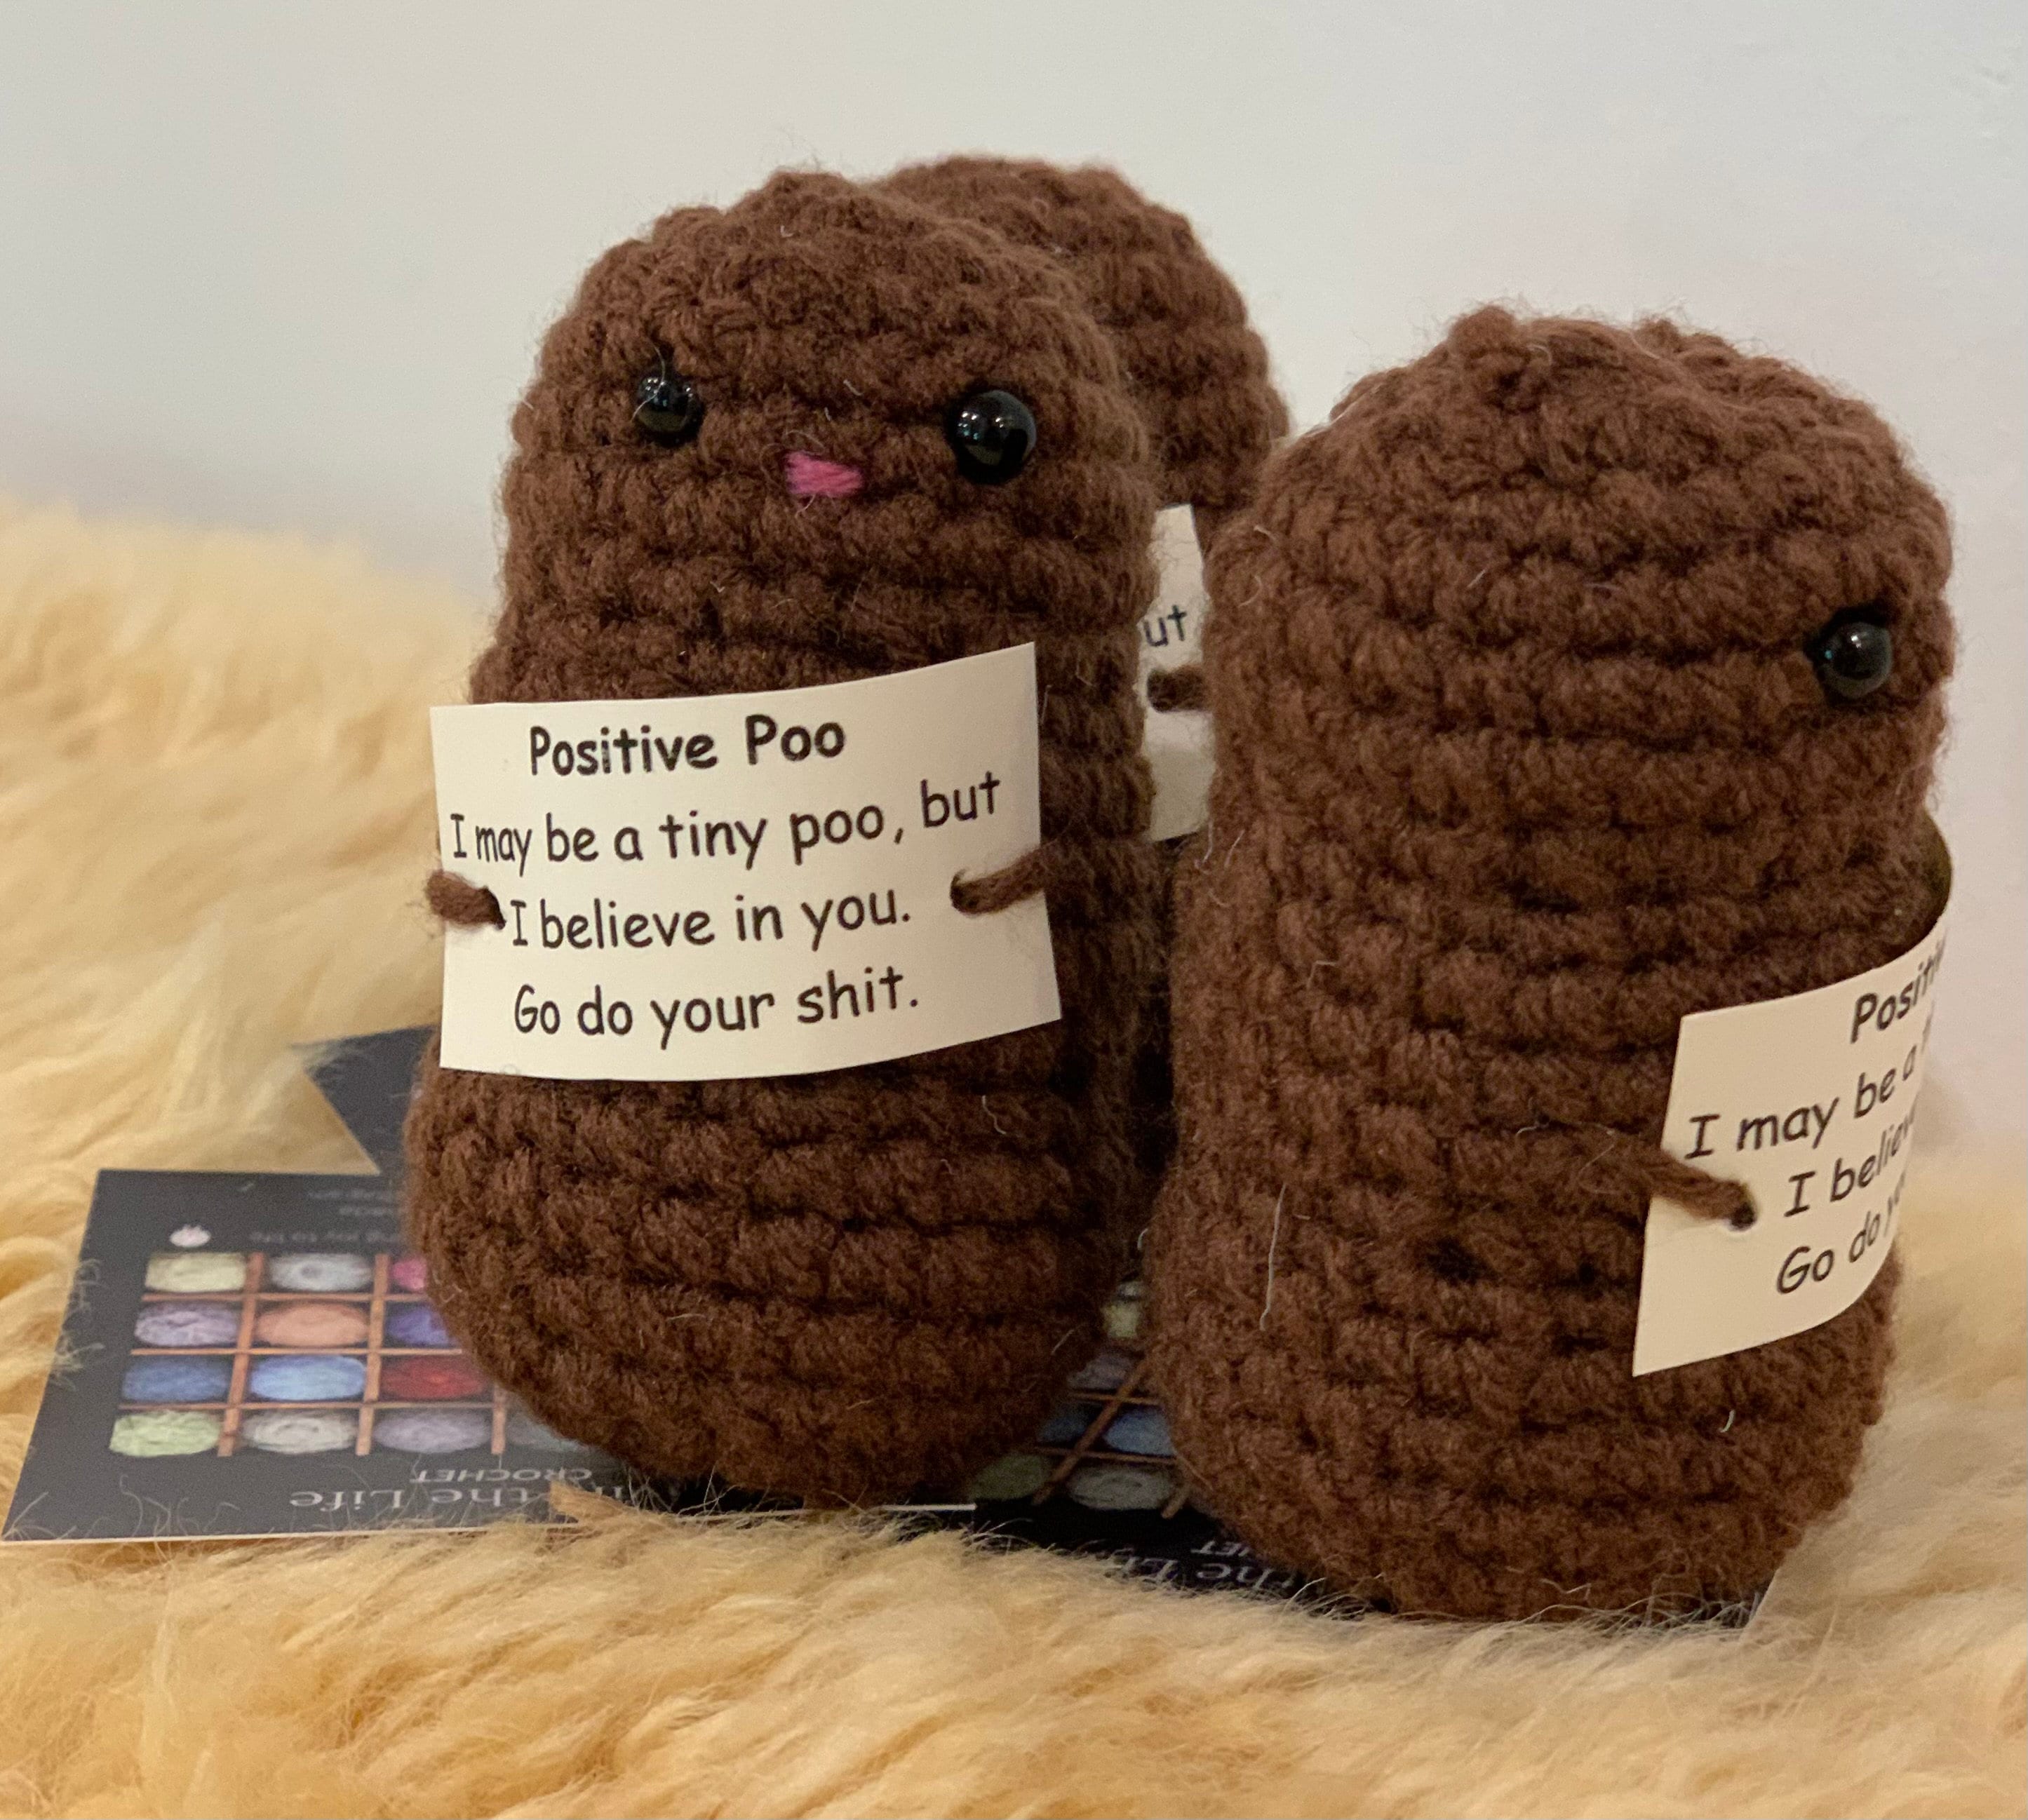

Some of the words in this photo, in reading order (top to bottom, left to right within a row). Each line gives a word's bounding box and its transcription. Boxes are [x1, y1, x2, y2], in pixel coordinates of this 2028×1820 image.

[1143, 605, 1187, 647] ut
[530, 724, 718, 776] Positive
[745, 713, 846, 766] Poo
[450, 813, 468, 860] I
[476, 823, 533, 877] may
[546, 812, 599, 863] be
[614, 828, 643, 861] a
[659, 809, 768, 870] tiny
[791, 804, 904, 865] poo,
[920, 769, 1002, 830] but
[511, 898, 528, 948] I
[539, 899, 715, 950] believe
[736, 896, 784, 942] in
[801, 889, 911, 952] you.
[513, 984, 560, 1037] Go
[577, 985, 633, 1037] do
[650, 990, 774, 1051] your
[797, 965, 918, 1025] shit.
[1685, 1114, 1719, 1159] I
[1735, 1096, 1839, 1150] may
[1854, 1071, 1895, 1119] be
[1902, 1044, 1917, 1081] a
[1784, 1171, 1815, 1217] I
[1776, 1246, 1834, 1295] Go
[1848, 1211, 1881, 1262] do
[289, 1489, 403, 1511] Life
[410, 1467, 593, 1484] CROCHET
[431, 1487, 531, 1508] the
